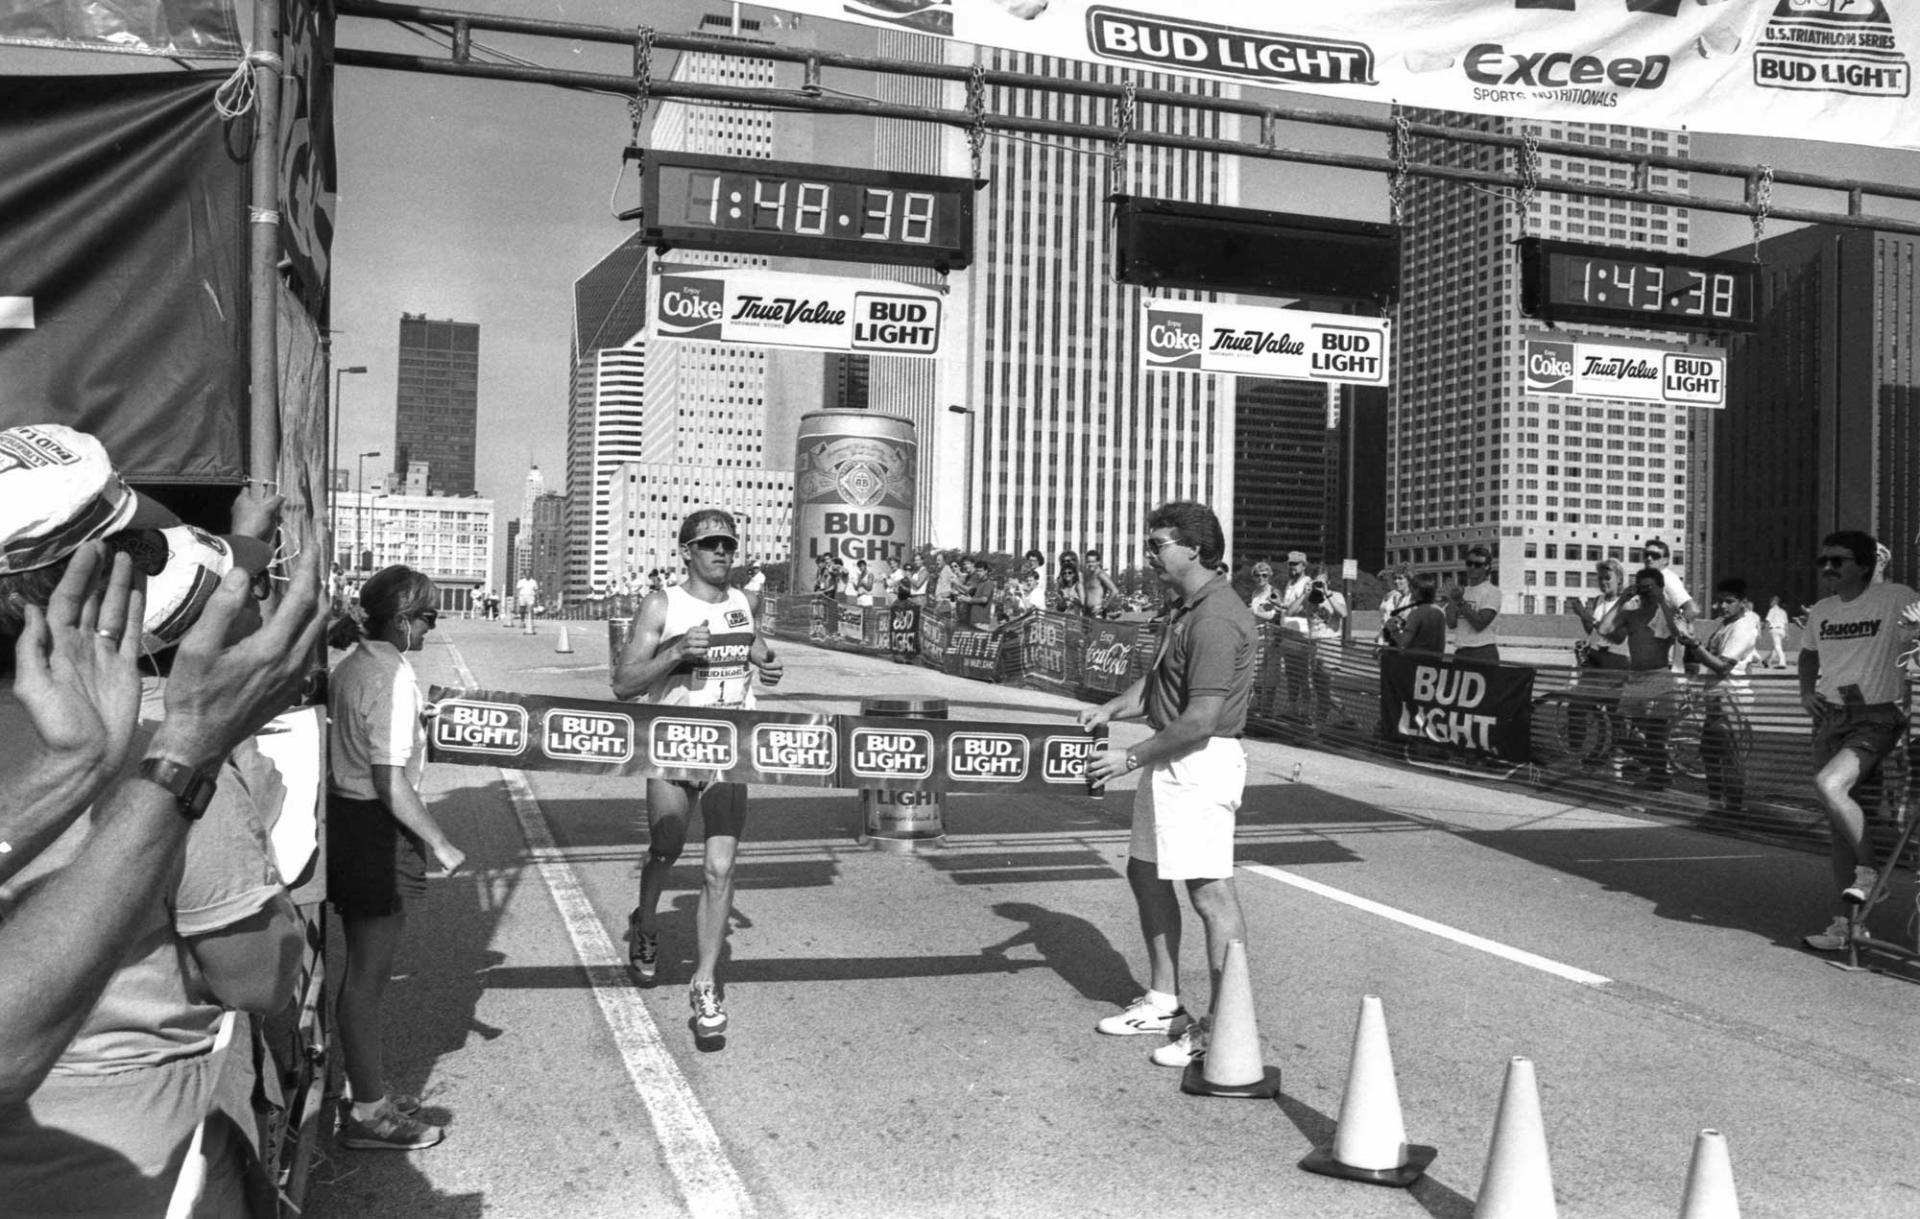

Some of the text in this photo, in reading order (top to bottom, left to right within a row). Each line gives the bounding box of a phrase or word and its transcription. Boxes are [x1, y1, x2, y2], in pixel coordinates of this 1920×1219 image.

[1858, 33, 1896, 49] SERIES
[1102, 21, 1361, 82] BUD LIGHT
[1761, 58, 1902, 88] BUD LIGHT
[1473, 87, 1526, 102] SPORTS
[662, 291, 723, 320] Coke
[869, 302, 927, 323] BUD
[854, 324, 934, 346] LIGHT
[1150, 325, 1201, 350] Coke
[1322, 333, 1370, 353] BUD
[1312, 354, 1378, 374] LIGHT
[1530, 354, 1572, 376] Coke
[1675, 360, 1713, 376] BUD
[1667, 376, 1720, 394] LIGHT
[824, 512, 895, 536] BUD
[810, 537, 906, 560] LIGHT
[1029, 622, 1056, 646] BUD
[1819, 619, 1882, 637] Saucony
[1413, 665, 1487, 708] BUD
[453, 707, 508, 727] BUD
[562, 717, 615, 736] BUD
[1398, 701, 1497, 751] LIGHT
[441, 724, 519, 745] LIGHT
[551, 733, 626, 753] LIGHT
[667, 724, 719, 744] BUD
[769, 730, 820, 749] BUD
[866, 735, 916, 753] BUD
[656, 741, 730, 761] LIGHT
[759, 747, 830, 766] LIGHT
[964, 739, 1012, 756] BUD
[857, 752, 926, 770] LIGHT
[954, 755, 1021, 773] LIGHT
[1049, 759, 1087, 774] LIG
